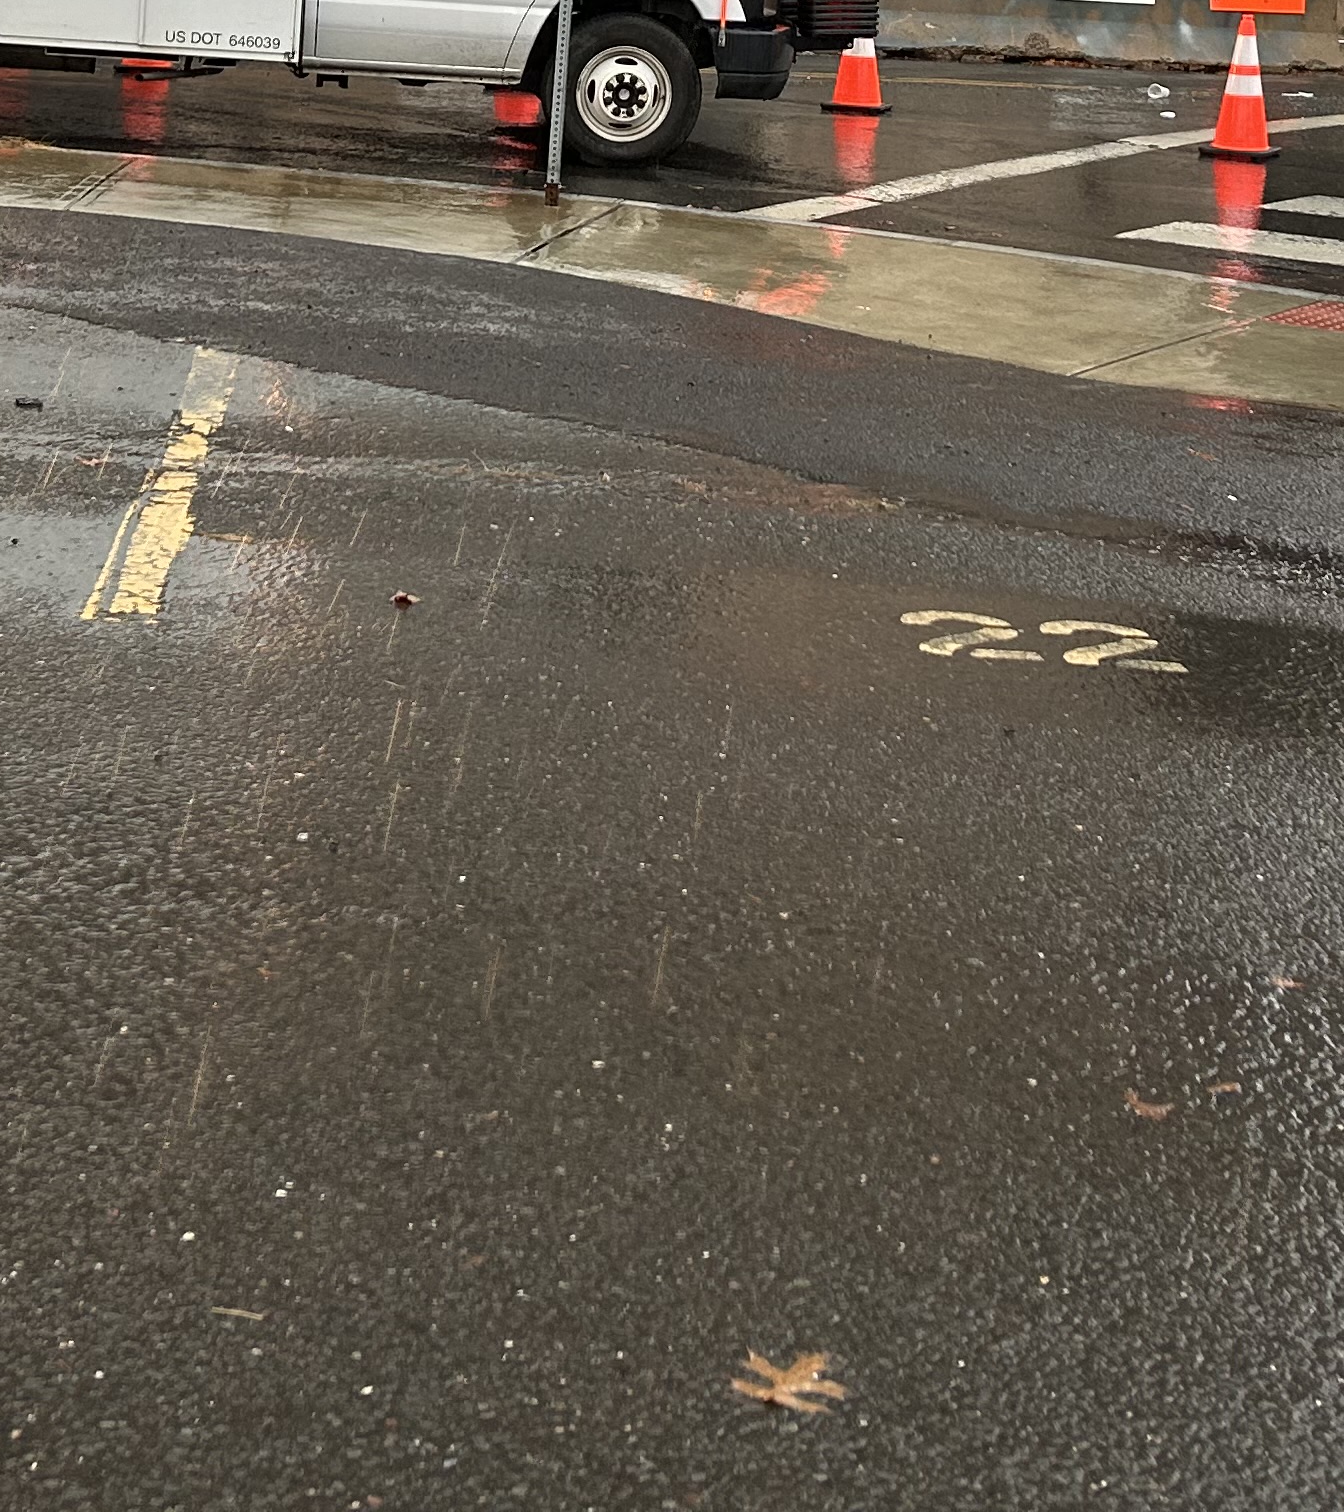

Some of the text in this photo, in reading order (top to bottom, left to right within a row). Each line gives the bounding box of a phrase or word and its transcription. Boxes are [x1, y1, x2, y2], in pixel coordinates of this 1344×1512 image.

[165, 30, 281, 49] US DOT 646039
[900, 609, 1190, 673] 22
